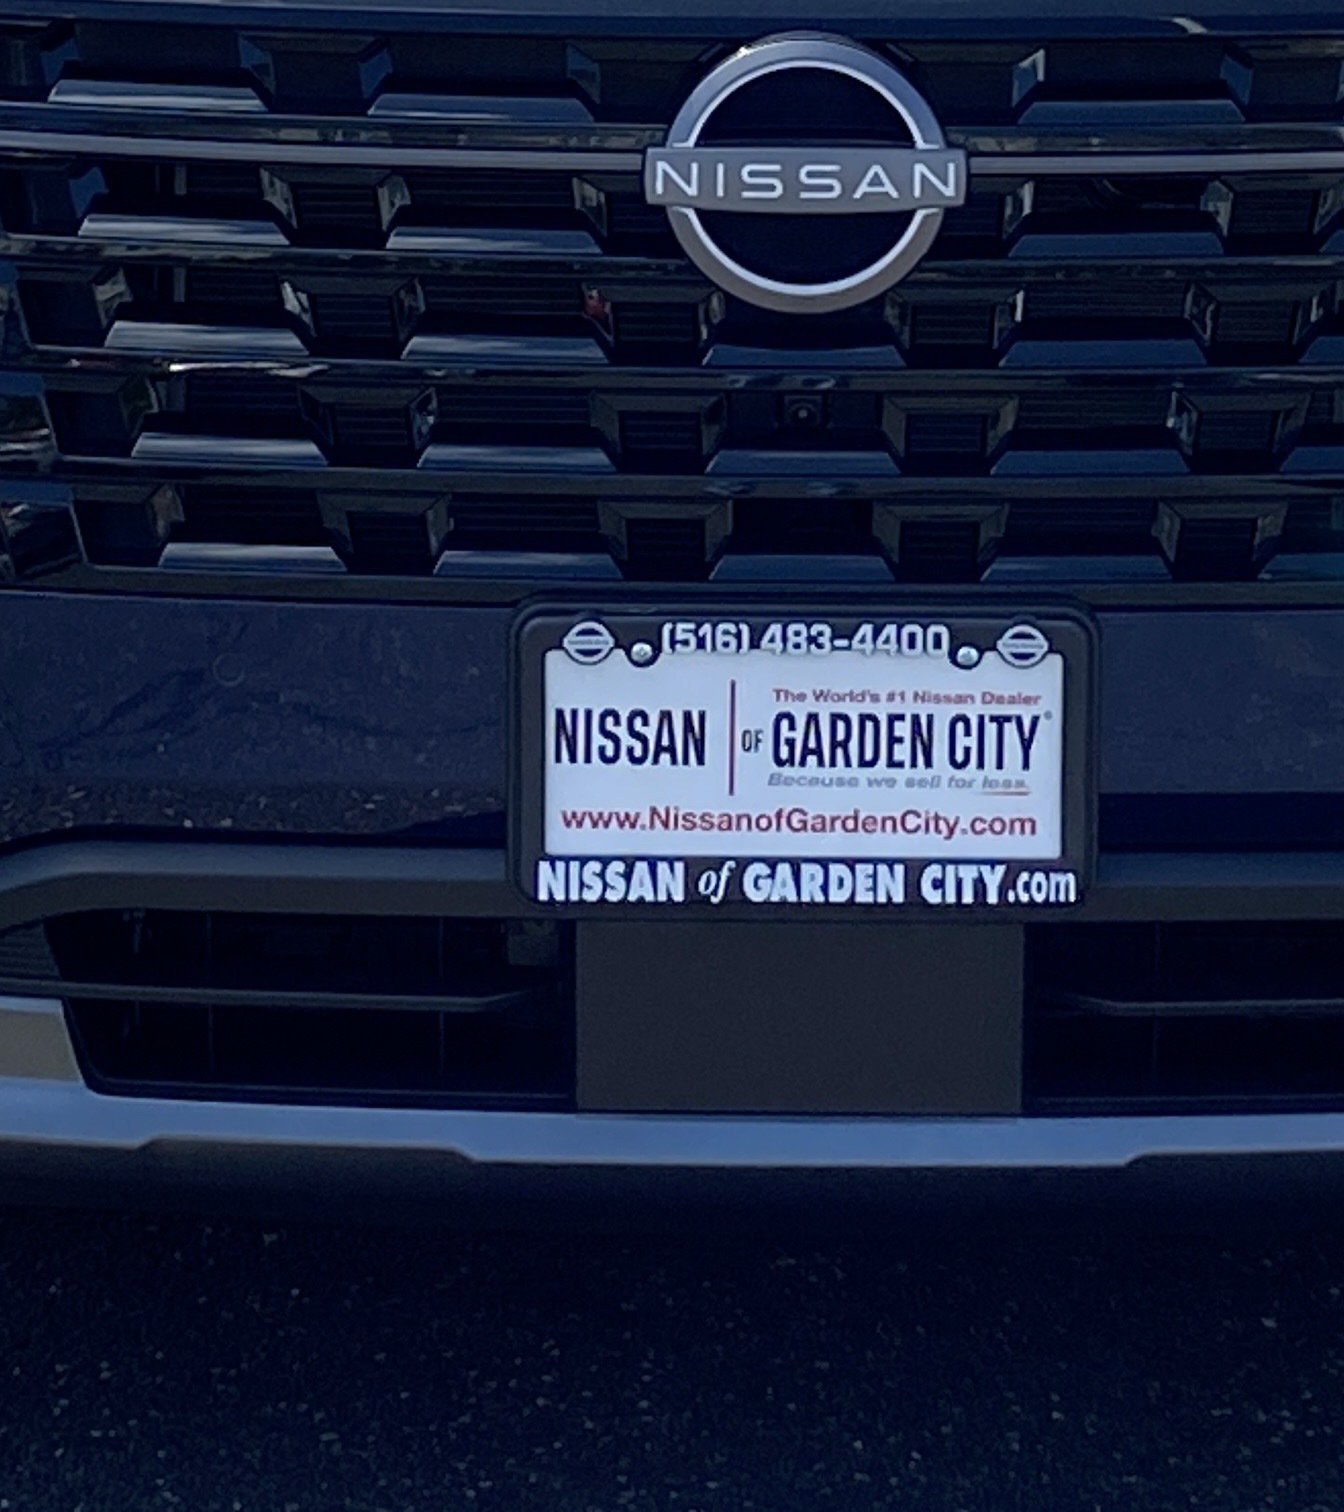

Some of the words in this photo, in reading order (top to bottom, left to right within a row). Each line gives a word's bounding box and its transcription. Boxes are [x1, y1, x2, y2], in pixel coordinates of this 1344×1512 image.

[656, 161, 955, 199] NISSAN
[661, 621, 750, 655] (516)
[760, 622, 950, 657] 483-4400
[772, 688, 807, 703] The
[812, 689, 881, 704] World's
[886, 691, 906, 704] #1
[912, 691, 976, 705] Nissan
[981, 691, 1041, 706] Dealer
[554, 707, 706, 766] NISSAN
[741, 727, 764, 753] OF
[772, 711, 935, 770] GARDEN
[948, 713, 1041, 771] CITY
[767, 772, 858, 788] Because
[867, 776, 897, 788] we
[904, 775, 942, 789] sell
[947, 775, 976, 789] for
[561, 806, 1037, 840] www.NissanofGardenCity.com
[537, 860, 686, 903] NISSAN
[697, 860, 737, 905] of
[742, 861, 906, 904] GARDEN
